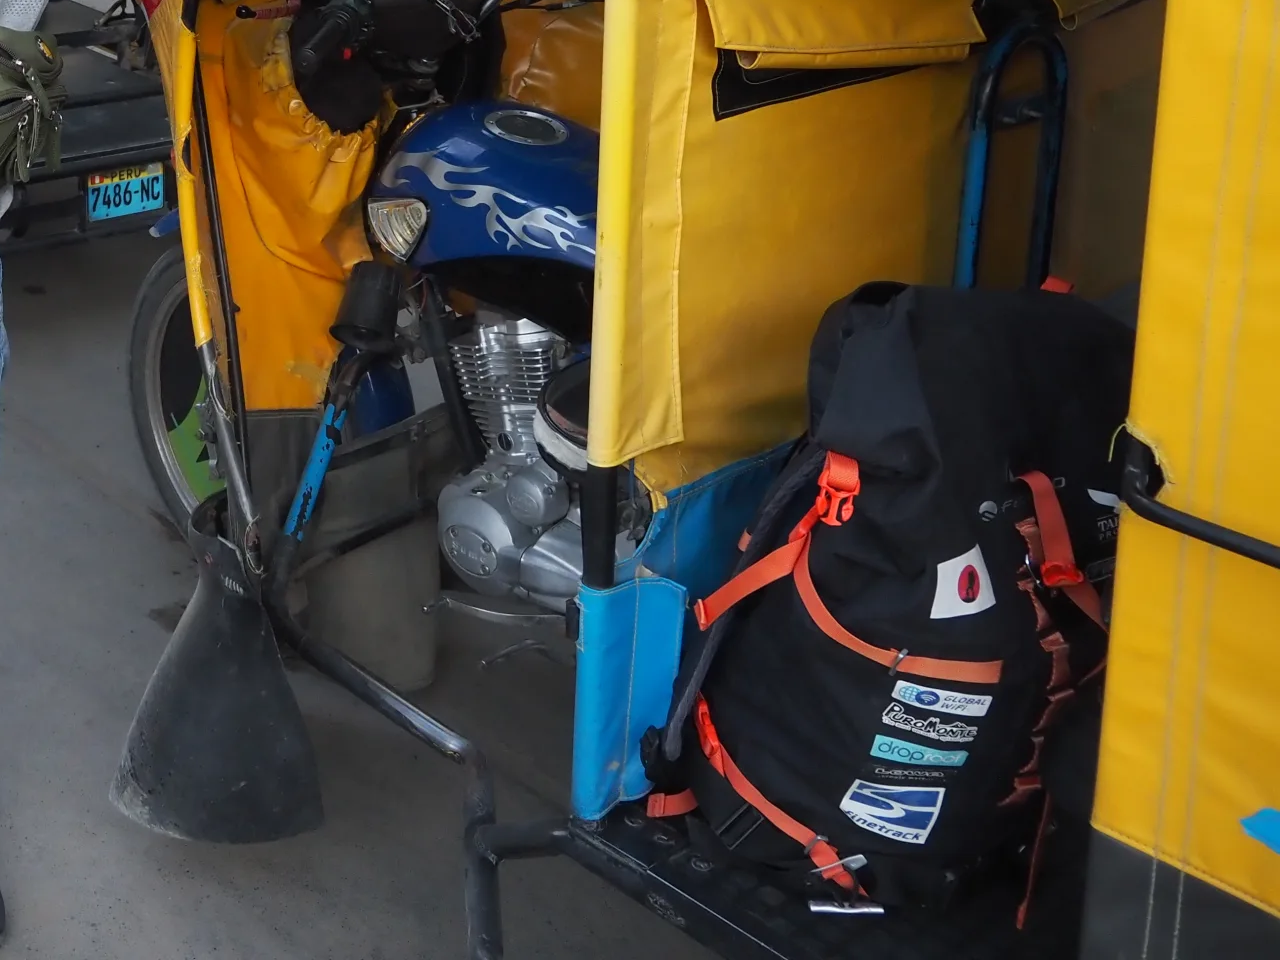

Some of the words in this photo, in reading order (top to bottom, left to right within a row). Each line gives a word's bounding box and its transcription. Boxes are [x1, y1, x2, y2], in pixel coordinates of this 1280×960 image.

[110, 167, 141, 182] PERU
[91, 176, 160, 213] 7486-NC
[943, 695, 988, 706] GLOBAL
[877, 740, 961, 763] droproof
[844, 810, 923, 841] finetrack
